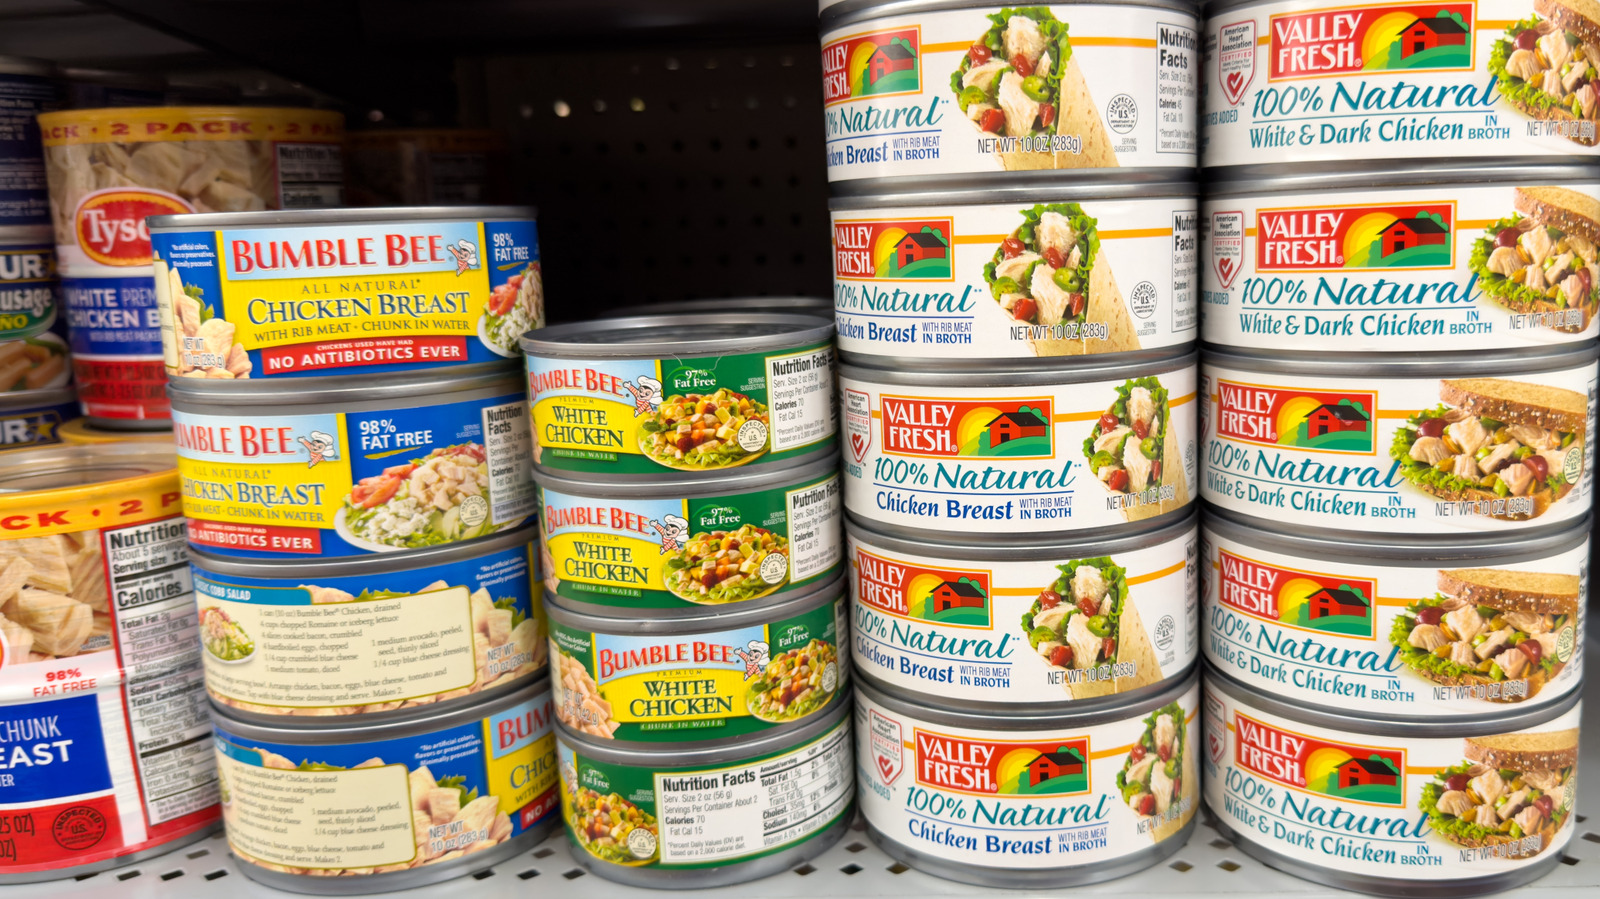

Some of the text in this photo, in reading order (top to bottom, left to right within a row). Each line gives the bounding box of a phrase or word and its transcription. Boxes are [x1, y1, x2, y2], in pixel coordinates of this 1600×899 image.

[1224, 25, 1249, 36] American
[1228, 34, 1244, 43] Heart
[1275, 13, 1362, 46] VALLEY
[1222, 40, 1252, 52] Association
[1160, 50, 1188, 70] Facts
[1278, 42, 1354, 73] FRESH
[1109, 96, 1136, 114] INSPECTED
[1252, 86, 1324, 118] 100%
[110, 122, 250, 136] 2 PACK
[1485, 115, 1498, 126] IN
[892, 136, 940, 148] WITH RIB MEAT
[1250, 116, 1463, 148] White & Dark Chicken
[1468, 128, 1510, 140] BROTH
[846, 141, 888, 164] Breast
[893, 149, 940, 161] IN BROTH
[978, 136, 1082, 154] NET WT 10 OZ (283g)
[84, 208, 150, 254] Tyso
[1261, 212, 1344, 239] VALLEY
[493, 233, 514, 247] 98%
[835, 226, 872, 249] VALLEY
[232, 238, 378, 274] BUMBLE
[385, 234, 445, 268] BEE
[495, 246, 529, 262] FAT FREE
[838, 252, 870, 274] FRESH
[1264, 240, 1336, 264] FRESH
[302, 284, 330, 294] ALL
[1241, 278, 1308, 305] 100%
[248, 292, 470, 325] CHICKEN BREAST
[362, 320, 470, 332] CHUNK IN WATER
[868, 322, 917, 342] Breast
[1010, 322, 1108, 340] NET WT 10 OZ (283g)
[1240, 312, 1444, 336] White & Dark Chicken
[270, 346, 460, 370] NO ANTIBIOTICS EVER
[772, 358, 810, 376] Nutrition
[530, 368, 625, 401] BUMBLE BEE
[675, 378, 716, 388] Fat Free
[686, 369, 708, 379] 97%
[774, 402, 797, 411] Calories
[1220, 386, 1276, 414] VALLEY
[552, 406, 608, 426] WHITE
[884, 402, 956, 427] VALLEY
[1222, 410, 1271, 440] FRESH
[360, 419, 396, 436] 98%
[546, 424, 624, 448] CHICKEN
[240, 426, 296, 457] BEE
[362, 430, 433, 450] FAT FREE
[890, 426, 951, 452] FRESH
[874, 458, 928, 485] 100%
[236, 482, 325, 508] BREAST
[876, 492, 1014, 520] Chicken Breast
[1020, 496, 1072, 508] WITH RIB MEAT
[1248, 484, 1366, 516] Dark Chicken
[1020, 508, 1072, 520] IN BROTH
[1435, 502, 1454, 516] NET
[1458, 502, 1474, 516] WT
[1478, 501, 1488, 514] 10
[1492, 500, 1504, 514] OZ
[546, 505, 650, 536] BUMBLE BEE
[199, 530, 313, 549] ANTIBIOTICS EVER
[573, 542, 632, 563] WHITE
[114, 555, 167, 574] Serving size
[565, 558, 649, 584] CHICKEN
[859, 555, 906, 588] VALLEY
[1221, 555, 1278, 591] VALLEY
[116, 580, 182, 608] Calories
[862, 579, 902, 611] FRESH
[1224, 580, 1273, 616] FRESH
[600, 642, 734, 679] BUMBLE BEE
[856, 636, 954, 683] Chicken Breast
[46, 667, 82, 682] 98%
[33, 678, 97, 698] FAT FREE
[644, 680, 716, 696] WHITE
[630, 696, 733, 717] CHICKEN
[874, 714, 896, 730] American
[878, 724, 891, 735] Heart
[872, 726, 900, 744] Association
[1238, 718, 1304, 759] VALLEY
[919, 736, 994, 767] VALLEY
[1242, 742, 1300, 784] FRESH
[663, 770, 756, 792] Nutrition Facts
[924, 760, 990, 791] FRESH
[664, 794, 696, 803] Serv. Size
[1225, 766, 1276, 809] 100%
[907, 786, 966, 820] 100%
[430, 820, 464, 838] NET WT
[666, 815, 706, 825] Calories 70
[764, 816, 788, 830] Sodium
[431, 840, 444, 852] 10
[908, 819, 1052, 854] Chicken Breast
